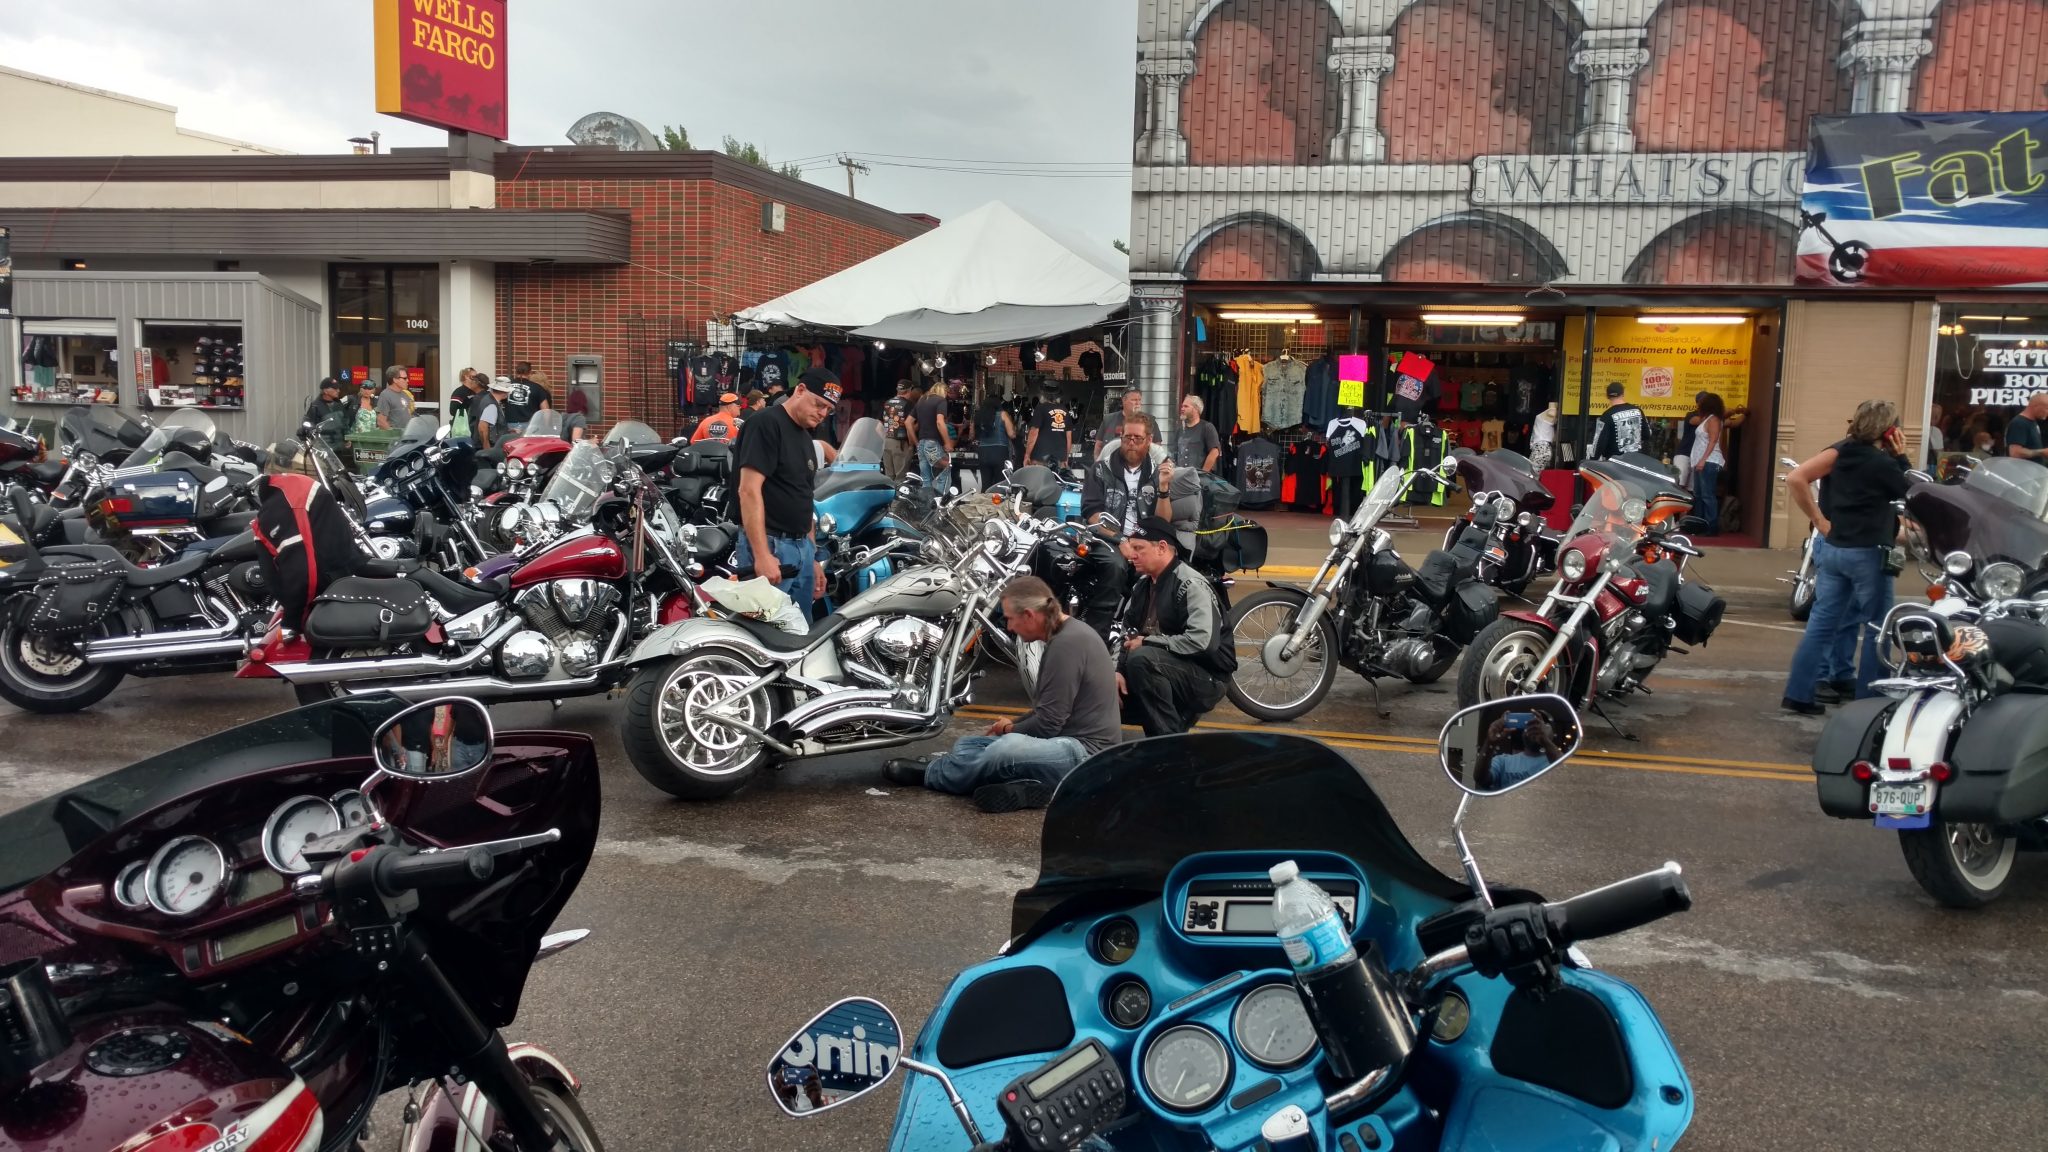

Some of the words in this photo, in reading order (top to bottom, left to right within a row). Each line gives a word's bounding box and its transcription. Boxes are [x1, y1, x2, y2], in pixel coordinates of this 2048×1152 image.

[413, 0, 495, 39] WELLS
[412, 18, 495, 70] FARGO
[1495, 156, 1730, 198] WHAT'S
[1860, 128, 2046, 221] Fat
[405, 319, 429, 329] 1040
[1593, 356, 1612, 364] elief
[1607, 346, 1673, 354] Commitment
[1691, 347, 1737, 355] Wellness
[1984, 348, 2048, 367] TATT
[1645, 375, 1671, 384] 100%
[1969, 388, 2048, 407] PIER
